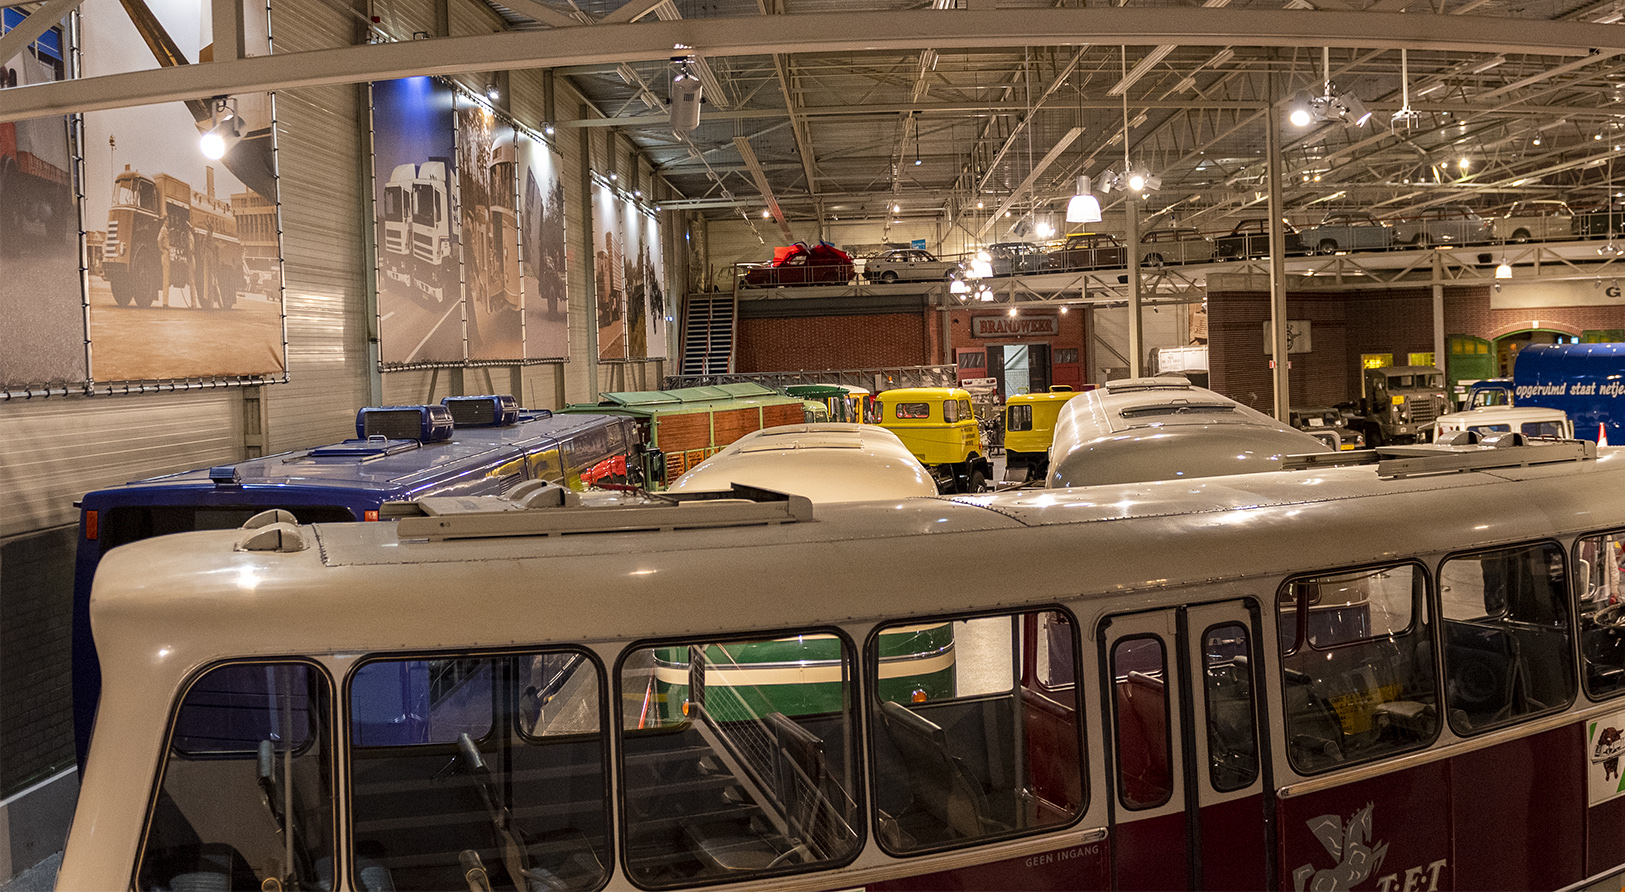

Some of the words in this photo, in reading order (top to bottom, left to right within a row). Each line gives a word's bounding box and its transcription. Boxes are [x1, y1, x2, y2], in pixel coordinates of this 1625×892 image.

[979, 319, 1054, 334] BRANDWEER
[1516, 382, 1567, 398] opgeruimd
[1569, 382, 1596, 395] staat
[1025, 853, 1053, 868] GEEN
[1057, 845, 1099, 862] INGANG
